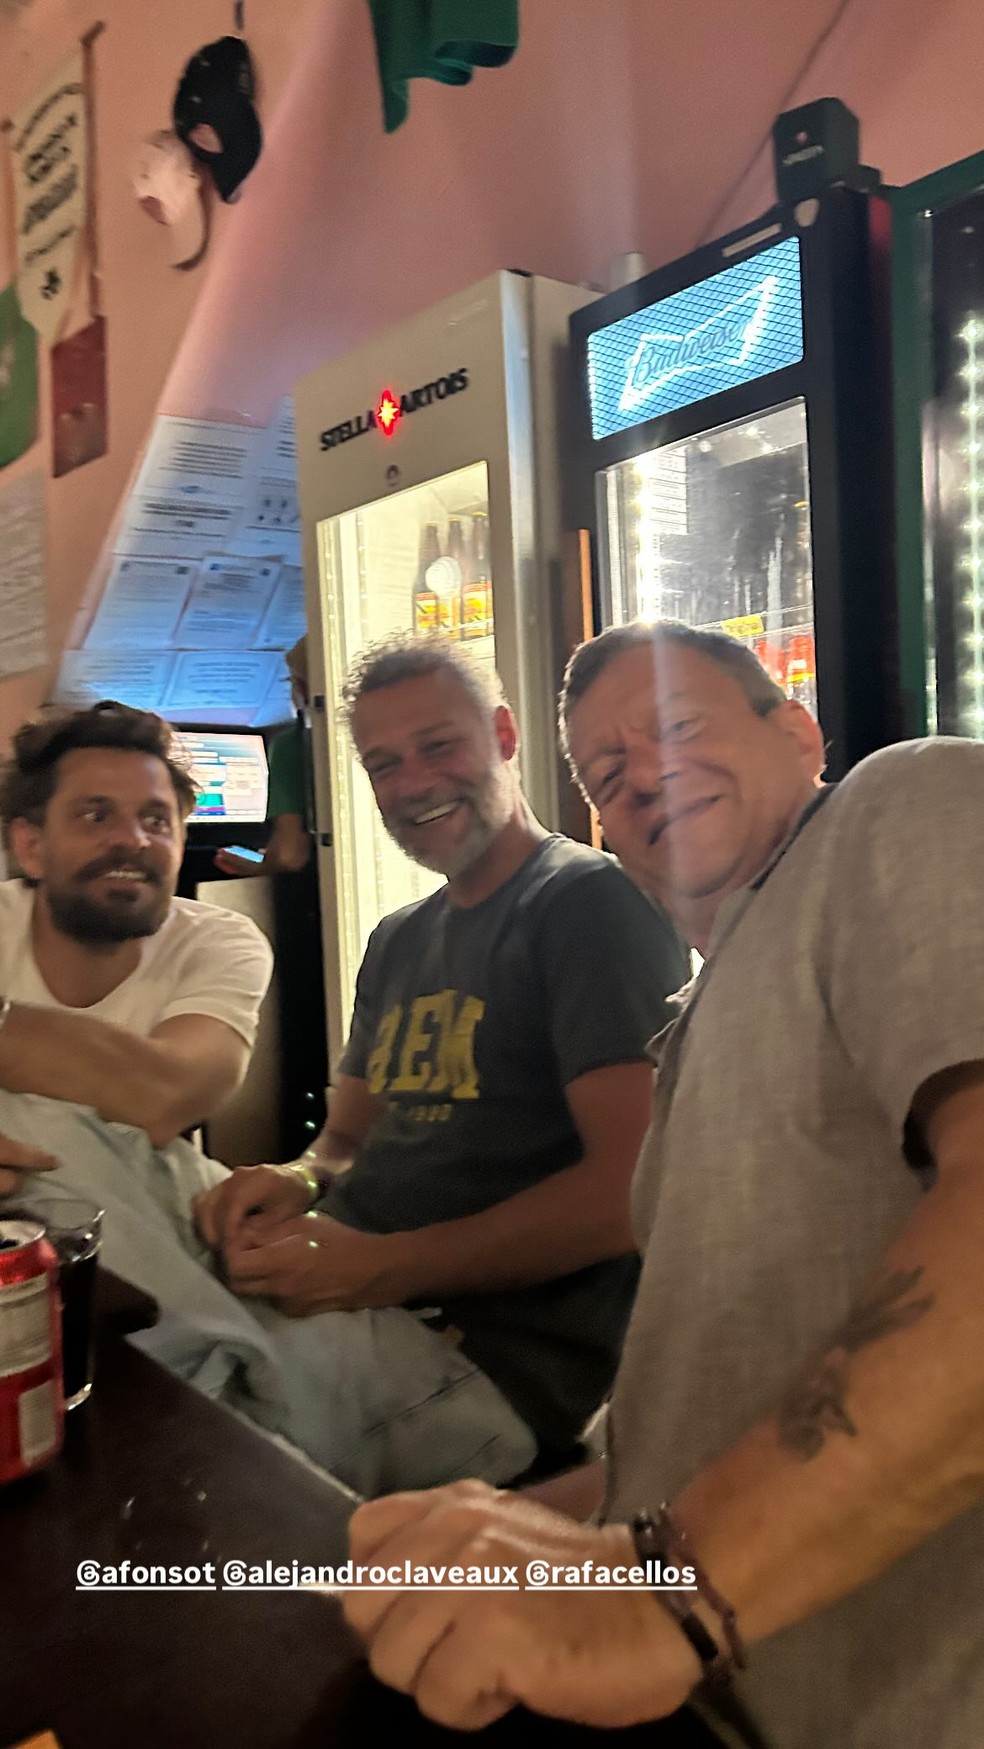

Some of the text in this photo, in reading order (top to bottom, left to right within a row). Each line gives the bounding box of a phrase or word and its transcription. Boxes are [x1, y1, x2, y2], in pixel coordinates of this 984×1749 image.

[626, 317, 750, 387] Budweiser
[320, 367, 468, 452] STELLA ARTOIS
